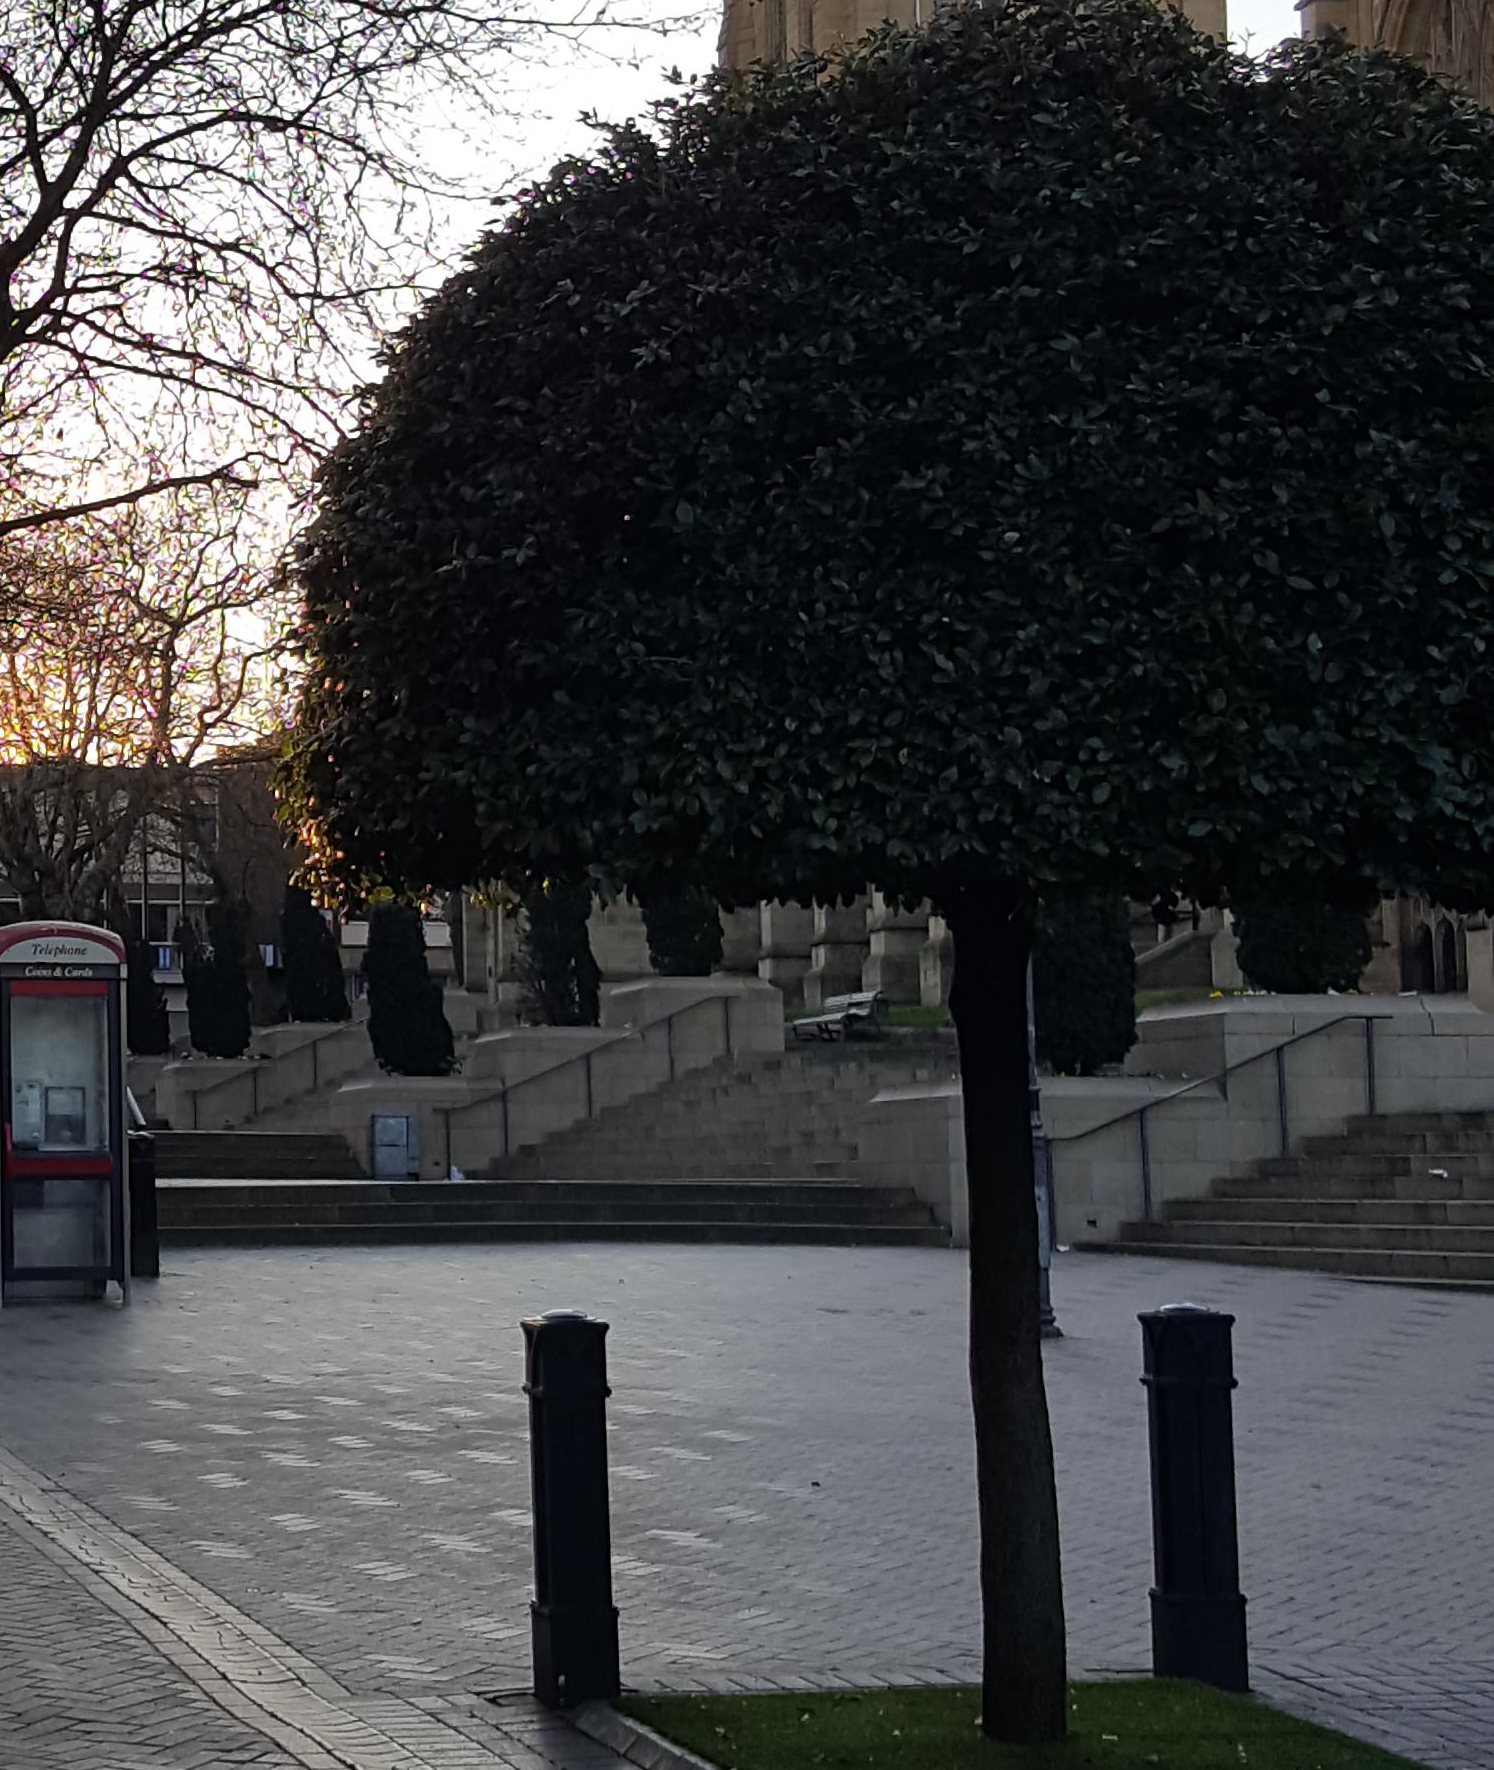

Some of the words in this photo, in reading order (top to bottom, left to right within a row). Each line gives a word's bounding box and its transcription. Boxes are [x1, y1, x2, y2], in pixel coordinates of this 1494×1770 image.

[32, 944, 88, 958] Telephone
[25, 965, 52, 977] Coins
[53, 966, 62, 977] &
[64, 966, 93, 977] Cards
